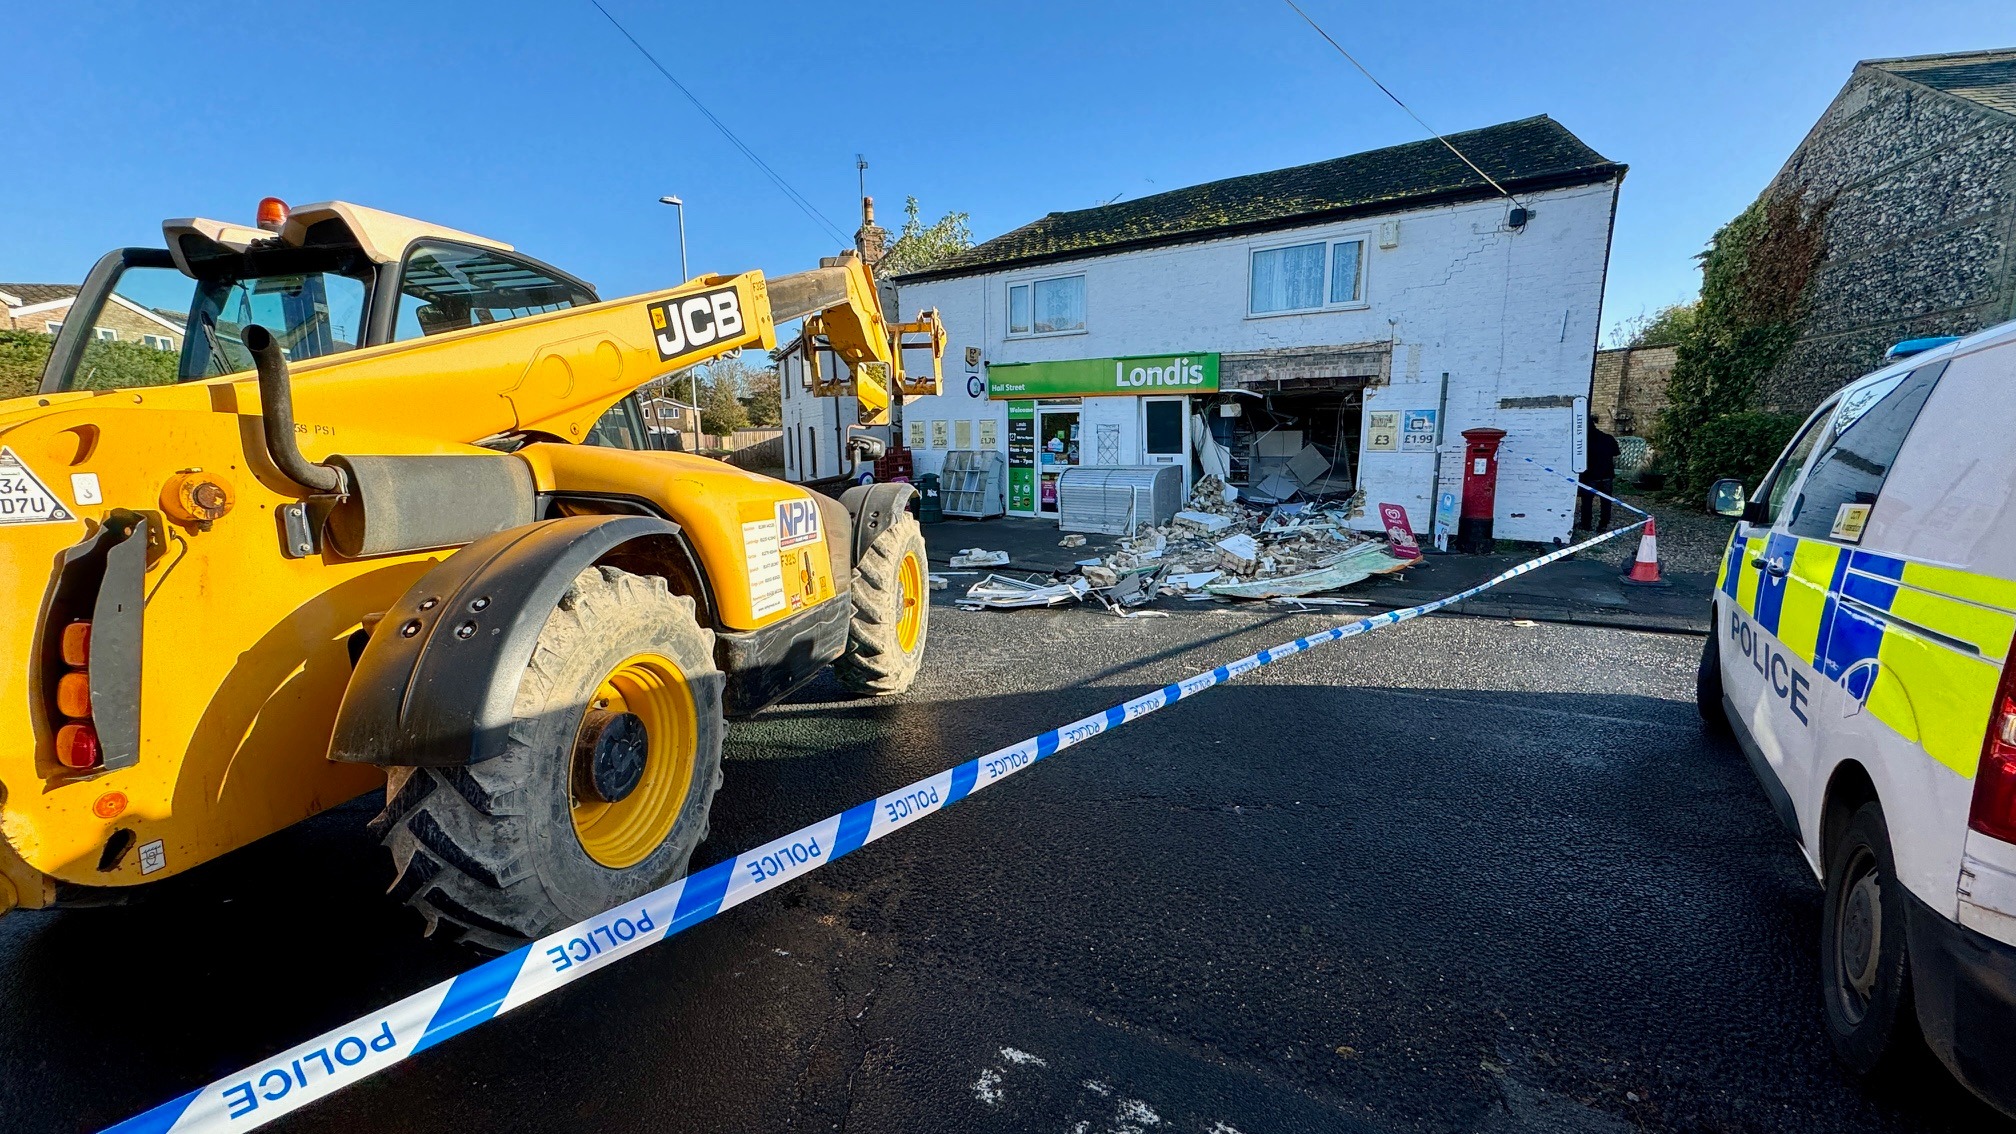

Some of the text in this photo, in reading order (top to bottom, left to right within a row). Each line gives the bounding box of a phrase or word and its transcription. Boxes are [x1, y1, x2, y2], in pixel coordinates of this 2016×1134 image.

[656, 290, 743, 356] JCB
[1116, 357, 1204, 387] Londis
[991, 383, 1026, 392] Hall Street
[314, 424, 336, 436] PSI
[933, 438, 948, 446] £2.50
[980, 437, 996, 445] £1.70
[1374, 434, 1390, 446] £3
[1404, 434, 1433, 444] £1.99
[779, 500, 817, 539] NPH
[1731, 610, 1810, 728] POLICE
[1129, 697, 1160, 718] POLICE
[1064, 721, 1101, 744] POLICE
[985, 749, 1029, 778] POLICE
[884, 785, 939, 823] POLICE
[746, 836, 822, 884] POLICE
[546, 908, 656, 973] POLICE
[221, 1020, 398, 1120] POLICE
